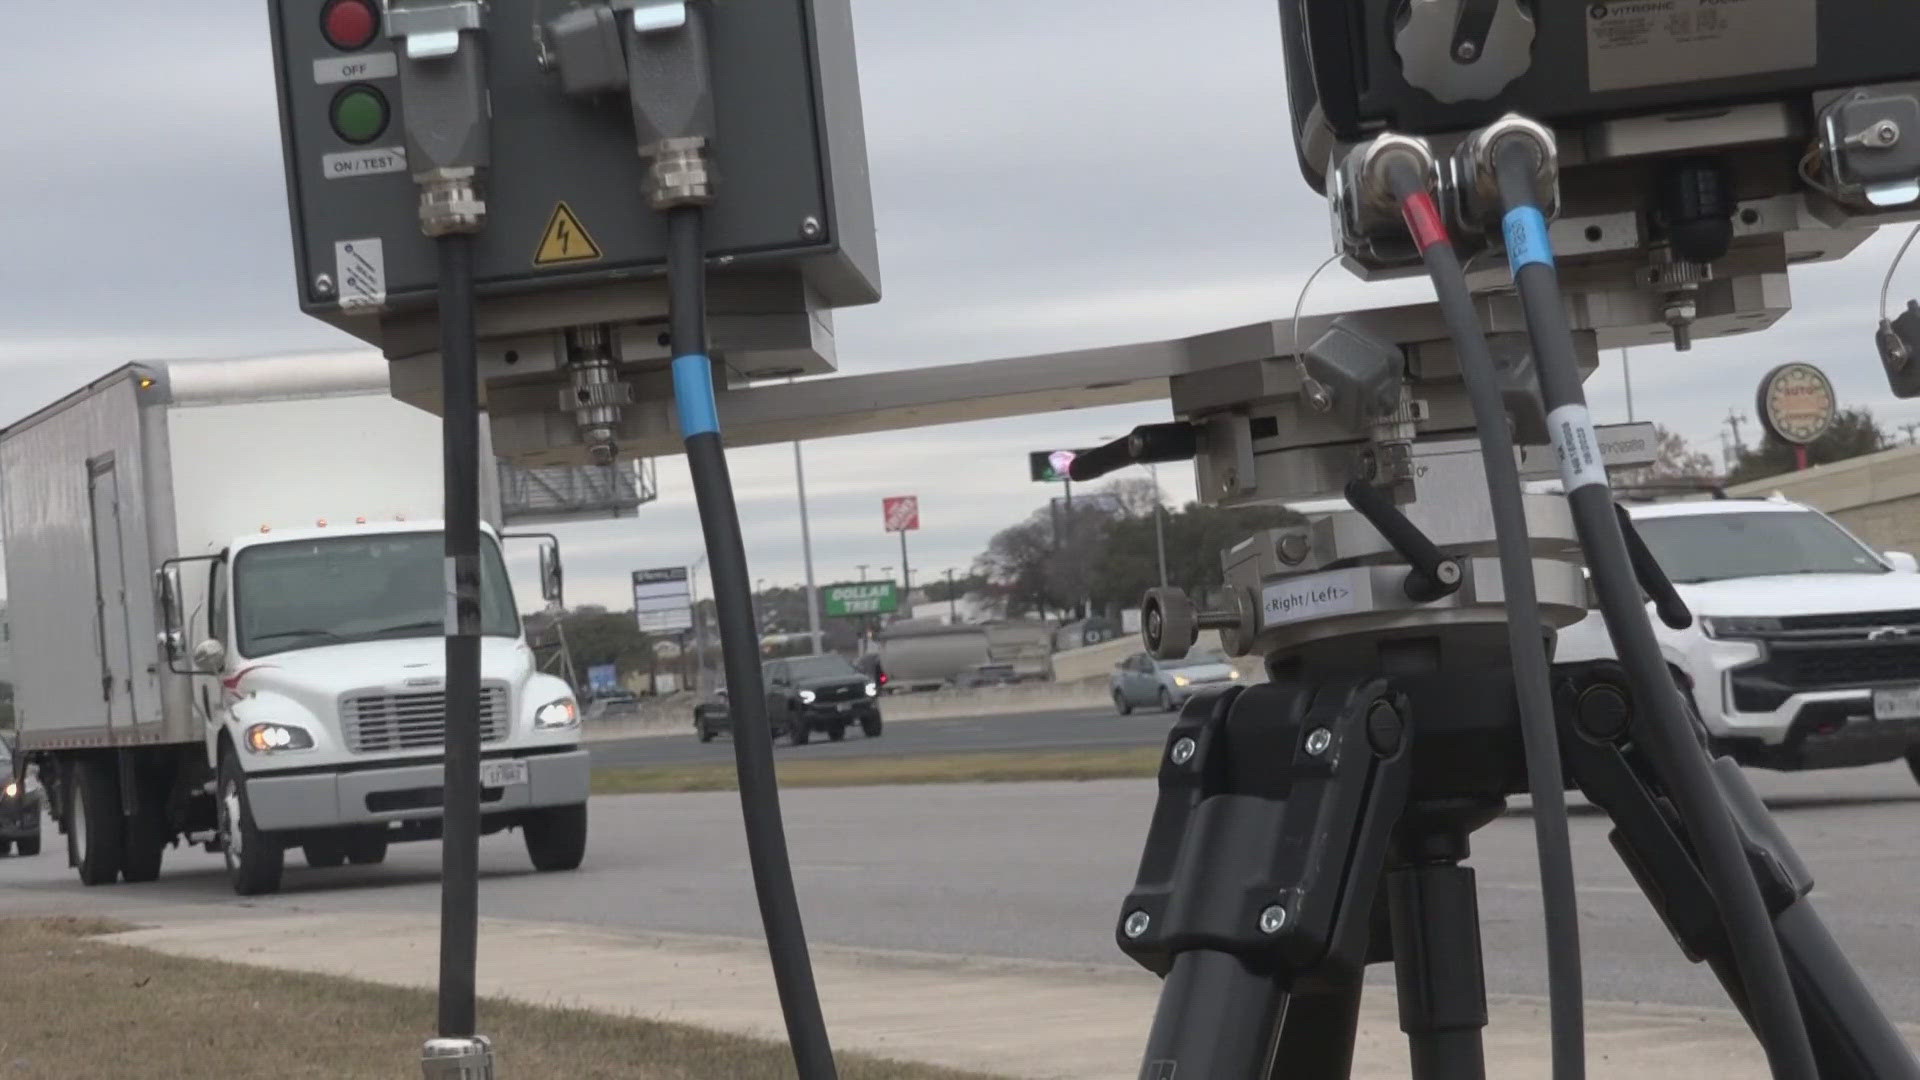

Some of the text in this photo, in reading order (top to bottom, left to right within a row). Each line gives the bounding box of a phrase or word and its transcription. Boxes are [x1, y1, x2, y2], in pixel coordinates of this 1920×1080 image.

[1610, 1, 1674, 17] VITRONIC
[342, 64, 367, 77] OFF
[334, 160, 353, 173] ON
[363, 156, 395, 169] TEST
[832, 584, 889, 601] DOLLAR
[844, 598, 879, 614] TREE
